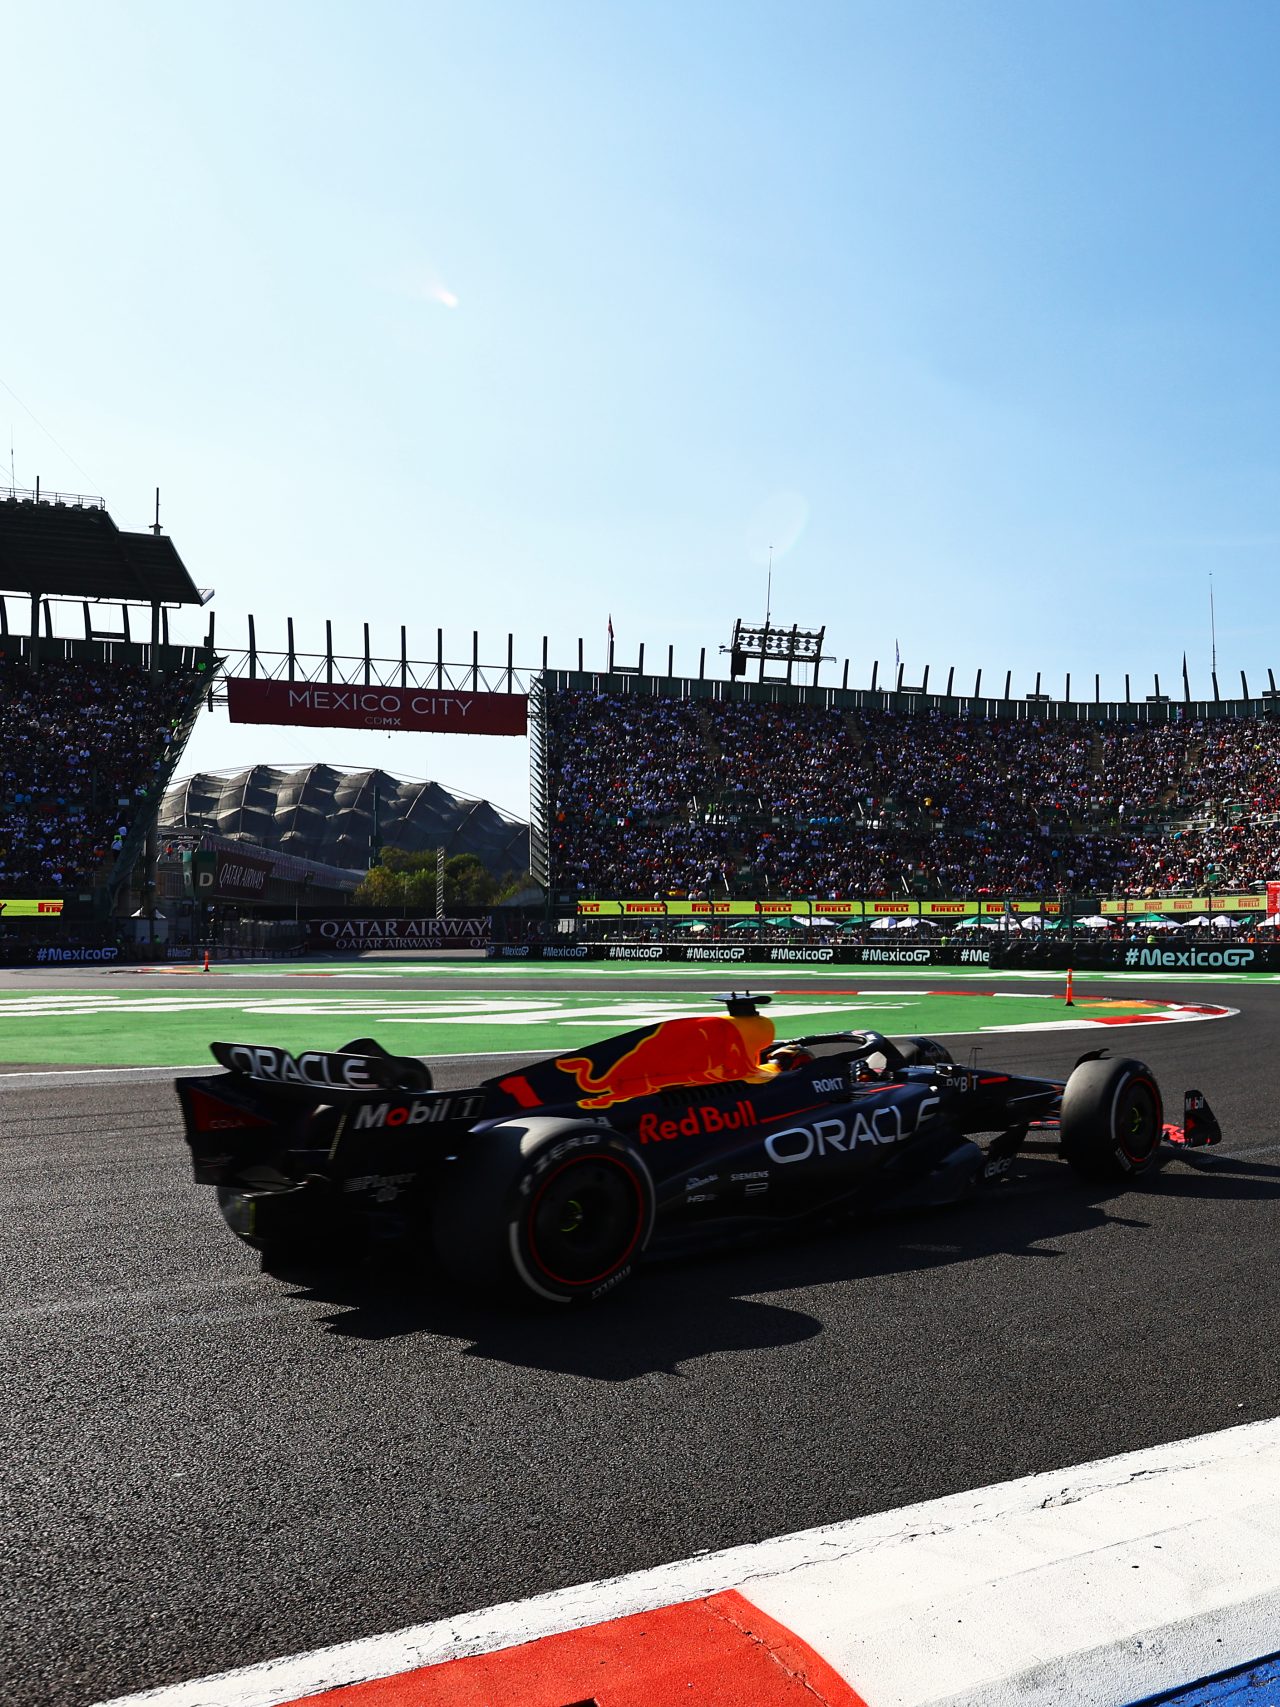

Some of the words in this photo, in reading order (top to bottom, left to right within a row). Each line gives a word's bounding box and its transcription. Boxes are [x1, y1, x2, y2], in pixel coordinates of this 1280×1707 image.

[288, 690, 400, 713] MEXICO
[411, 697, 473, 717] CITY
[365, 716, 401, 726] CDMX
[199, 872, 214, 887] D
[219, 863, 243, 888] QATAR
[755, 904, 792, 912] PIRELLI
[816, 904, 852, 912] PIRELLI
[874, 904, 909, 912] PIRELLI
[931, 904, 965, 912] PIRELLI
[320, 921, 398, 938] QATAR
[336, 938, 383, 949] QATAR
[385, 938, 442, 949] AIRWAYS
[36, 947, 118, 960] #MexicoGP
[542, 946, 588, 957] #MexicoGP
[609, 946, 663, 958] #MexicoGP
[686, 947, 745, 960] #MexicoGP
[770, 947, 834, 961] #MexicoGP
[862, 948, 931, 962] #MexicoGP
[1125, 948, 1255, 966] #MexicoGP
[229, 1046, 380, 1089] ORACLE
[498, 1076, 544, 1108] 1
[812, 1077, 845, 1094] ROKT
[353, 1098, 450, 1129] Mobil
[640, 1106, 701, 1146] Red
[700, 1099, 759, 1134] Bull
[730, 1170, 769, 1182] SIEMENS
